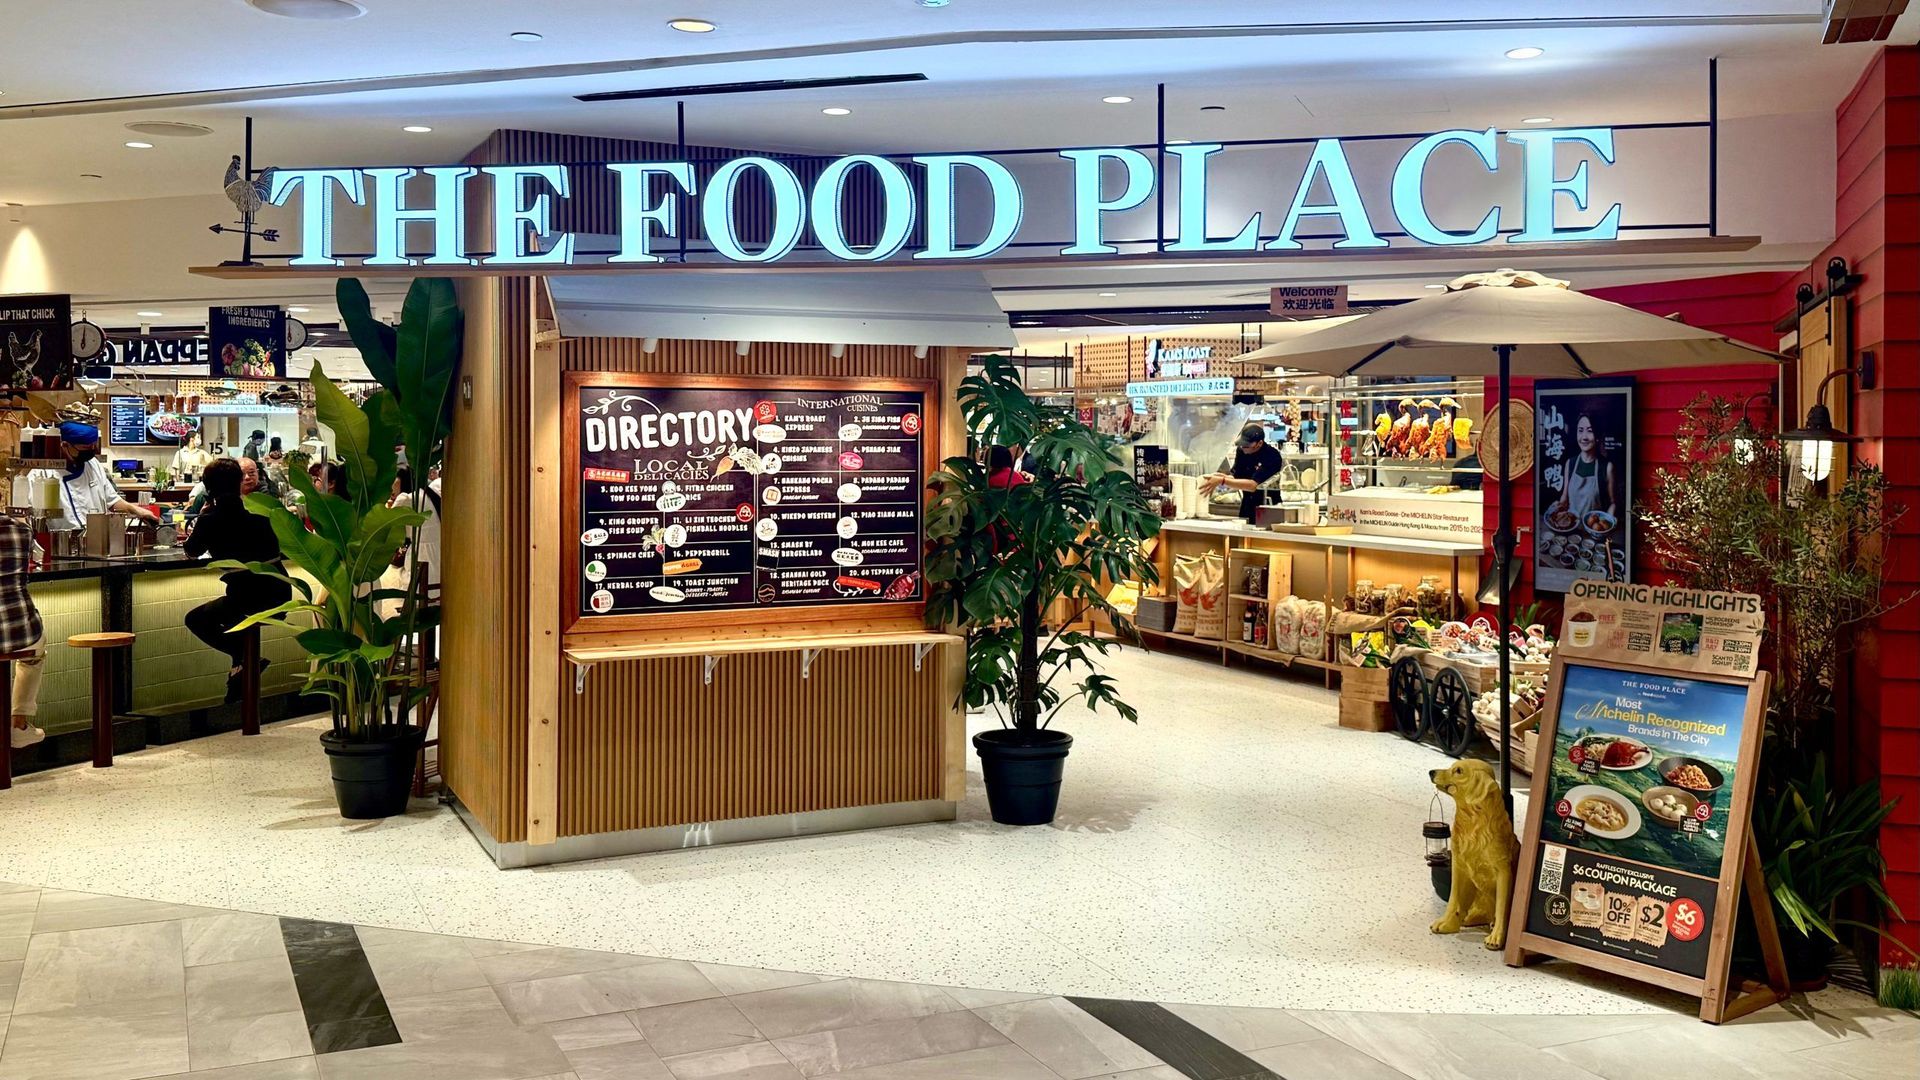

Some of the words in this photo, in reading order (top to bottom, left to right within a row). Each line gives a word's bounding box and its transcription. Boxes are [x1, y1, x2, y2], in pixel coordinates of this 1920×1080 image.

[269, 164, 575, 266] THE
[606, 154, 1024, 264] FOOD
[1058, 127, 1621, 255] PLACE
[1279, 286, 1338, 297] Welcome!
[1282, 298, 1334, 310] 欢迎光临
[11, 309, 30, 320] THAT
[31, 308, 55, 319] CHICK
[221, 306, 243, 316] FRESH
[250, 308, 276, 319] QUALITY
[228, 316, 271, 328] INGREDIENTS
[1139, 384, 1169, 394] ROASTED
[1170, 383, 1204, 392] DELIGHTS
[797, 395, 883, 410] INTERNATIONAL
[847, 404, 878, 412] CUISINES
[585, 407, 753, 453] DIRECTORY
[209, 442, 223, 455] 15
[633, 459, 709, 474] LOCAL
[633, 471, 709, 480] DELICACIES
[609, 485, 623, 493] KOO
[625, 485, 638, 493] KEE
[640, 485, 658, 493] YONG
[626, 517, 659, 525] GROUPER
[1443, 514, 1469, 522] Restaurant
[719, 524, 748, 532] NOODLES
[1449, 524, 1463, 532] 2015
[685, 549, 730, 557] PEPPERGRILL
[758, 547, 780, 557] SMASH
[707, 578, 739, 586] JUNCTION
[1573, 583, 1648, 603] OPENING
[1652, 589, 1757, 613] HIGHLIGHTS
[1599, 614, 1616, 622] FREE
[1705, 616, 1740, 624] MICROGREENS
[1622, 680, 1637, 688] THE
[1640, 682, 1660, 691] FOOD
[1662, 686, 1686, 694] PLACE
[1615, 697, 1642, 710] Most
[1575, 699, 1644, 723] Michelin
[1646, 713, 1727, 737] Recognized
[1627, 724, 1661, 738] Brands
[1662, 729, 1670, 737] In
[1671, 730, 1689, 743] The
[1690, 733, 1710, 747] City
[1595, 863, 1616, 871] RAFFLES
[1627, 869, 1655, 880] EXCLUSIVE
[1572, 864, 1584, 875] $6
[1584, 867, 1629, 886] COUPON
[1629, 878, 1677, 897] PACKAGE
[1608, 896, 1631, 914] 10%
[1551, 908, 1566, 916] JULY
[1607, 910, 1631, 925] OFF
[1640, 904, 1665, 928] $2
[1675, 903, 1697, 926] $6
